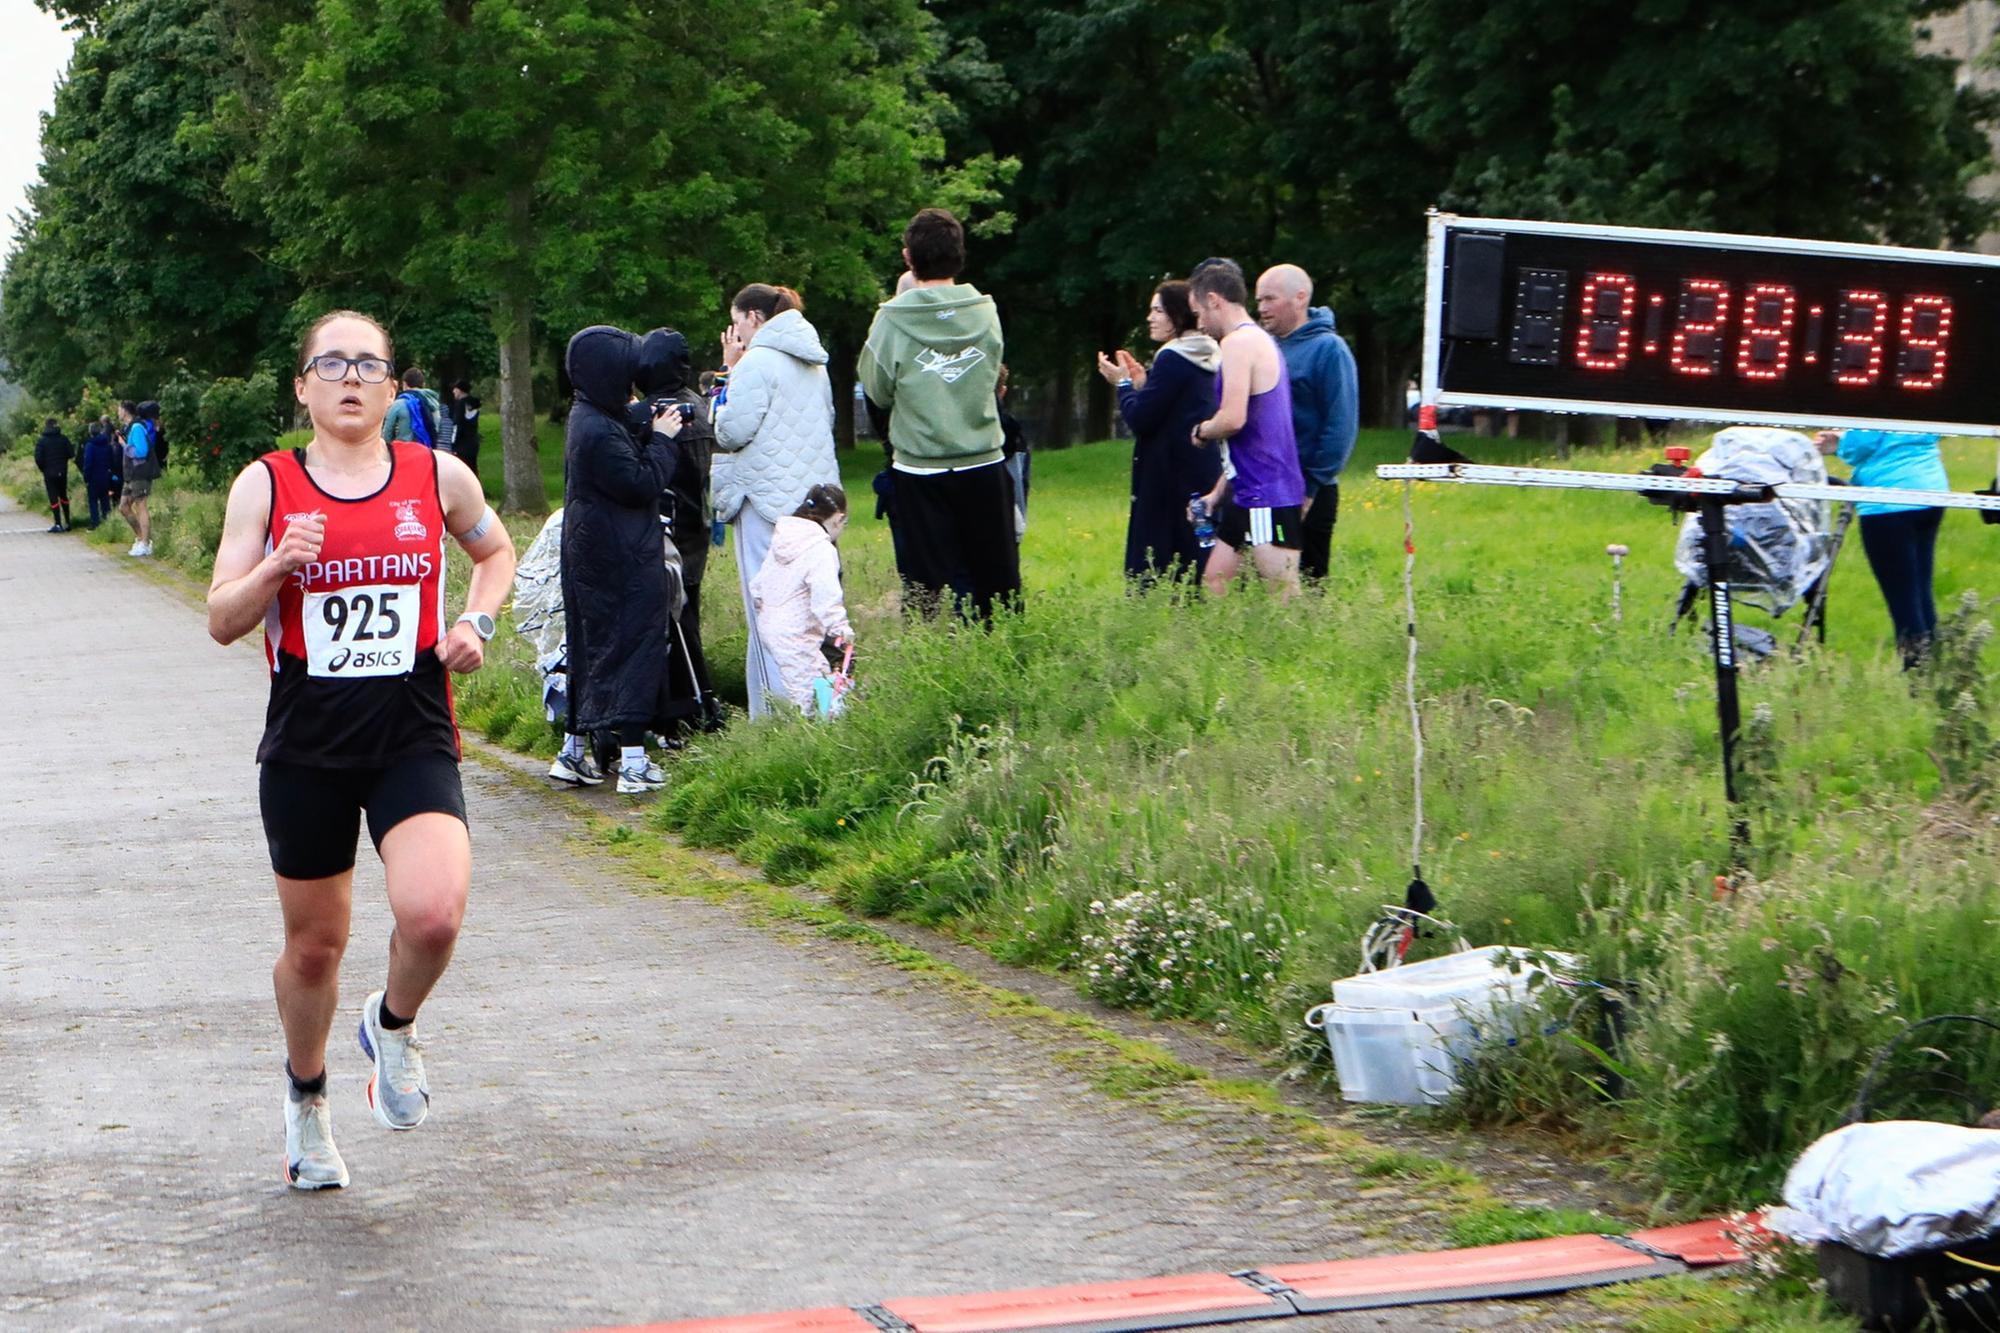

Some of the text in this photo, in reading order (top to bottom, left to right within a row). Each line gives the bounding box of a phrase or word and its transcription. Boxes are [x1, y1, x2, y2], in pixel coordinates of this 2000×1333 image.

[1575, 272, 1955, 390] 0:28:39
[292, 553, 432, 587] SPARTANS
[322, 592, 401, 641] 925
